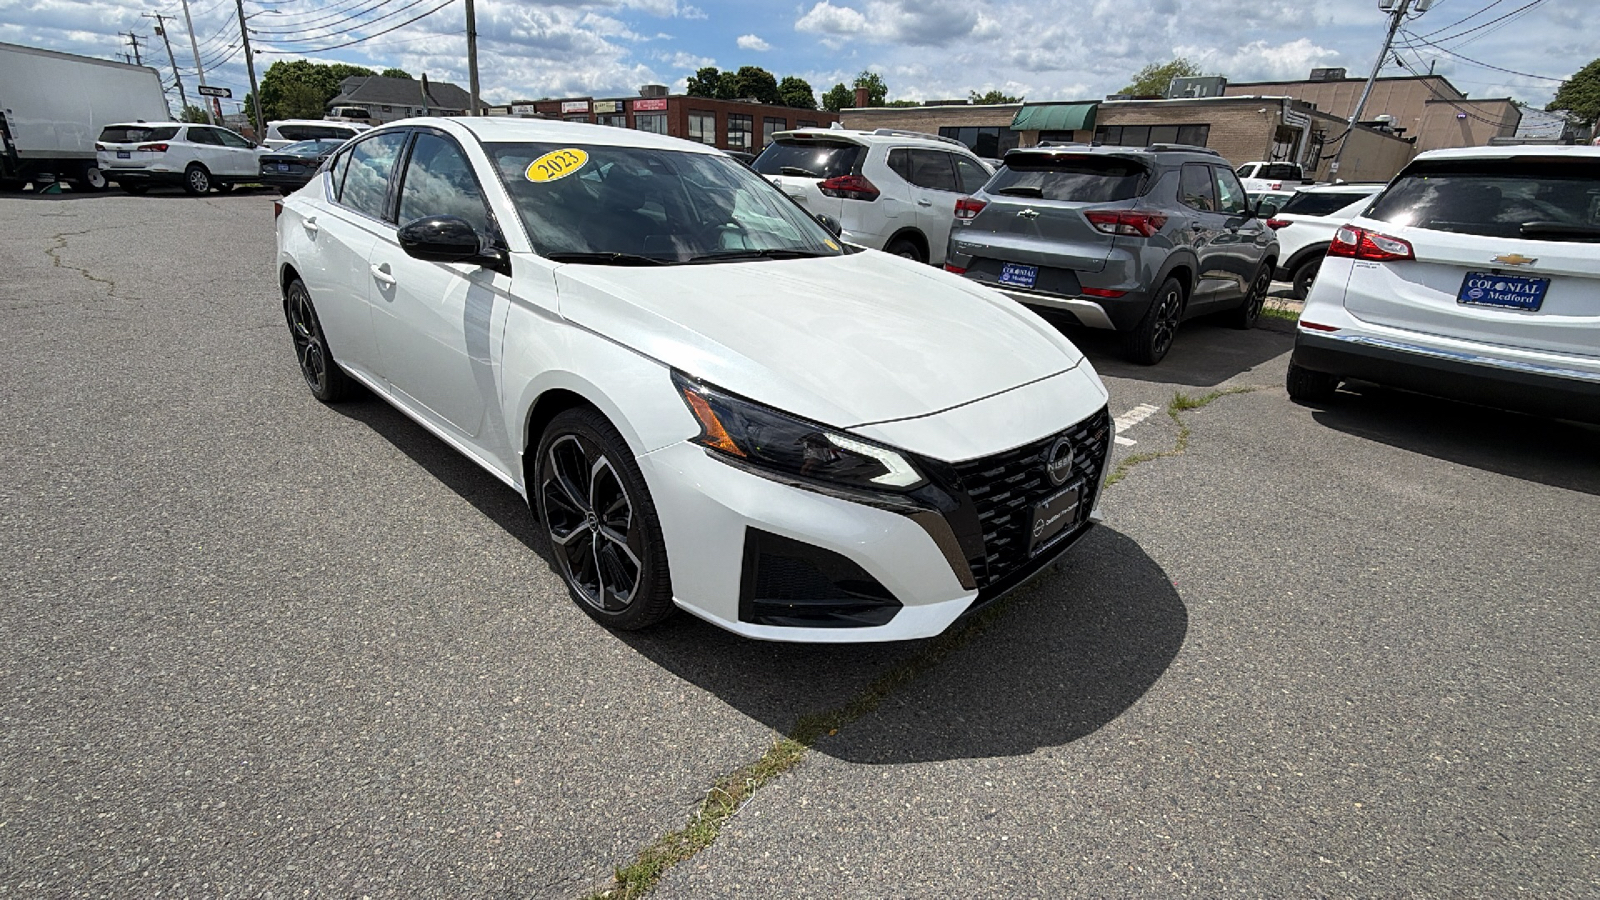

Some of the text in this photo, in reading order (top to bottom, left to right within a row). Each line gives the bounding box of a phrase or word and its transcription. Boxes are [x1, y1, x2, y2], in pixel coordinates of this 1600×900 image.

[537, 151, 579, 179] 2023
[1002, 266, 1036, 278] COLONIAL
[1468, 278, 1540, 294] COLONIAL
[1487, 291, 1534, 303] Medford
